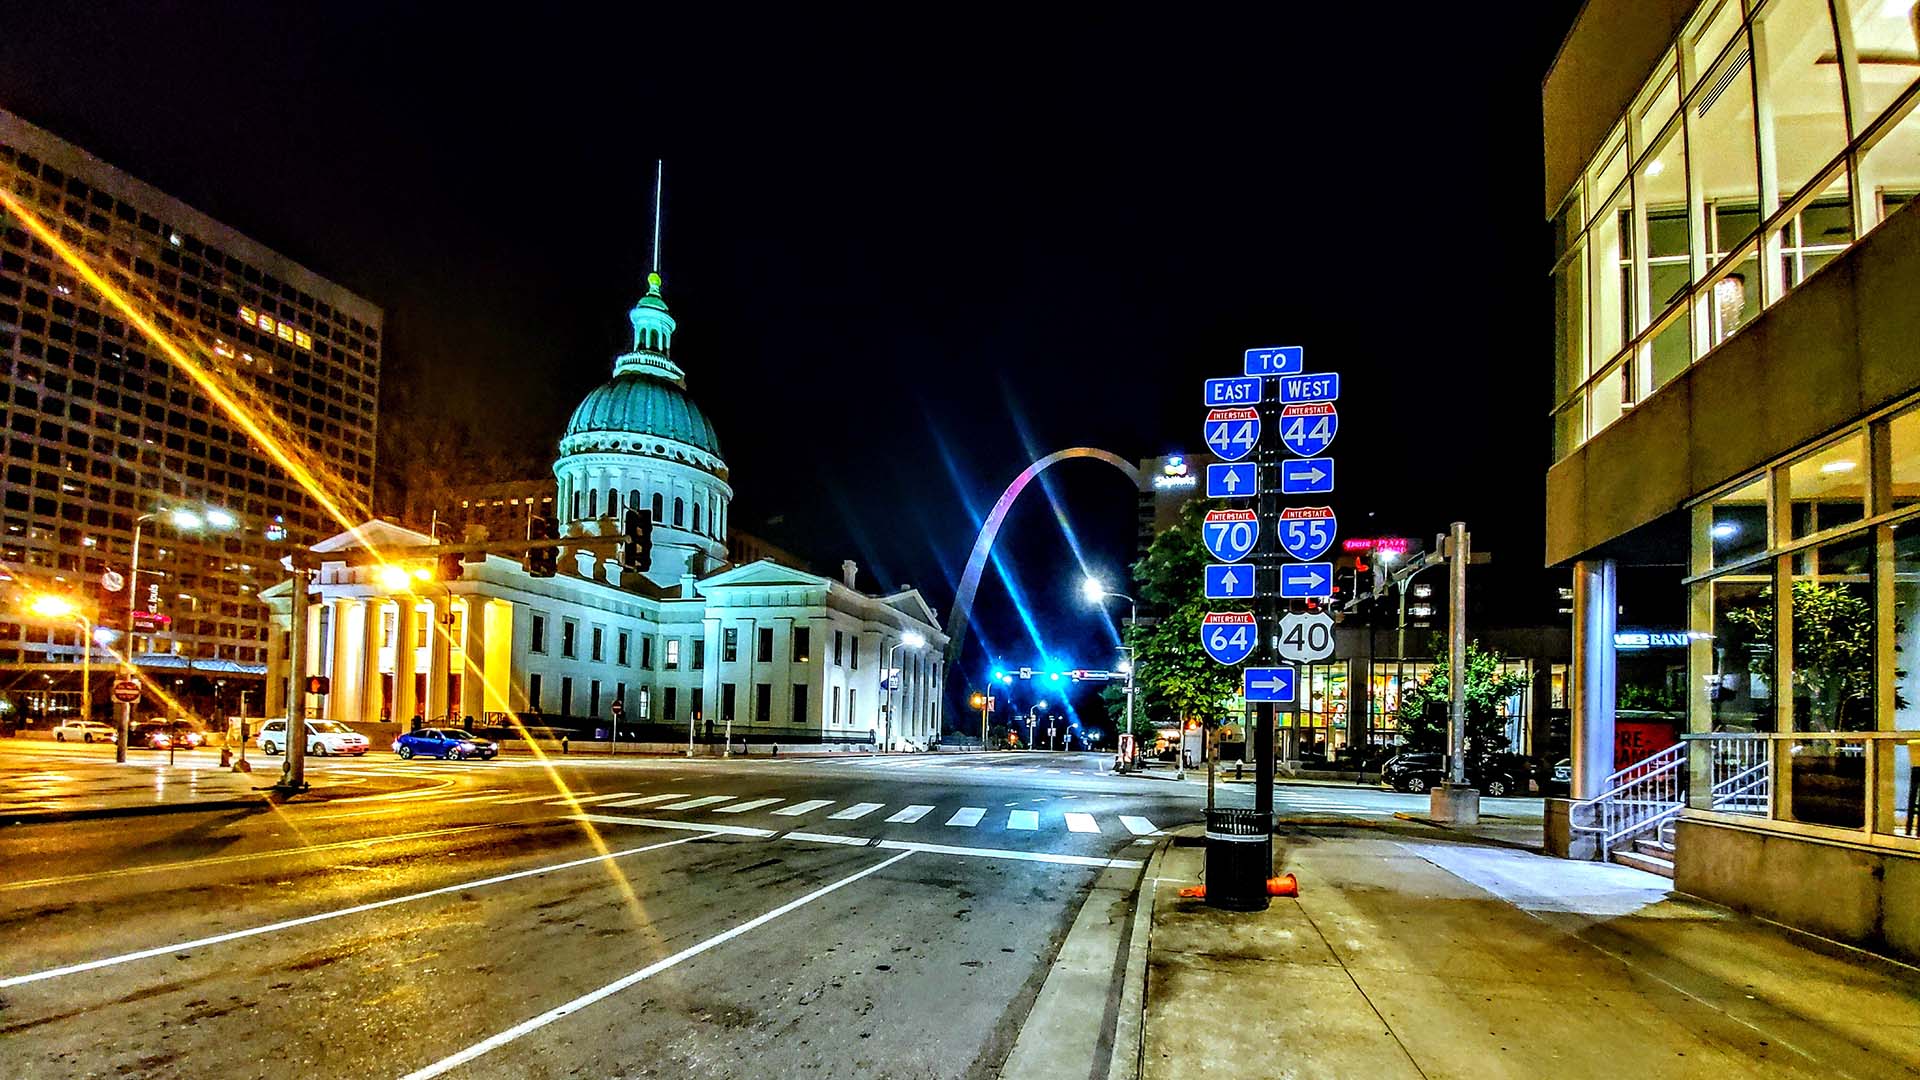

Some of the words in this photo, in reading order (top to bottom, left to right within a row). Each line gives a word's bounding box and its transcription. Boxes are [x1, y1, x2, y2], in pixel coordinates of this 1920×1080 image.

[1260, 353, 1286, 369] TO
[1214, 384, 1251, 400] EAST
[1288, 380, 1330, 398] WEST
[1213, 411, 1252, 419] INTERSTATE
[1288, 406, 1329, 415] INTERSTATE
[1209, 421, 1254, 450] 44
[1284, 416, 1331, 446] 44
[1211, 513, 1250, 521] INTERSTATE
[1287, 509, 1327, 518] INTERSTATE
[1209, 523, 1252, 552] 70
[1289, 520, 1327, 550] 55
[1210, 615, 1249, 623] INTERSTATE
[1210, 626, 1248, 651] 64
[1283, 622, 1329, 652] 40
